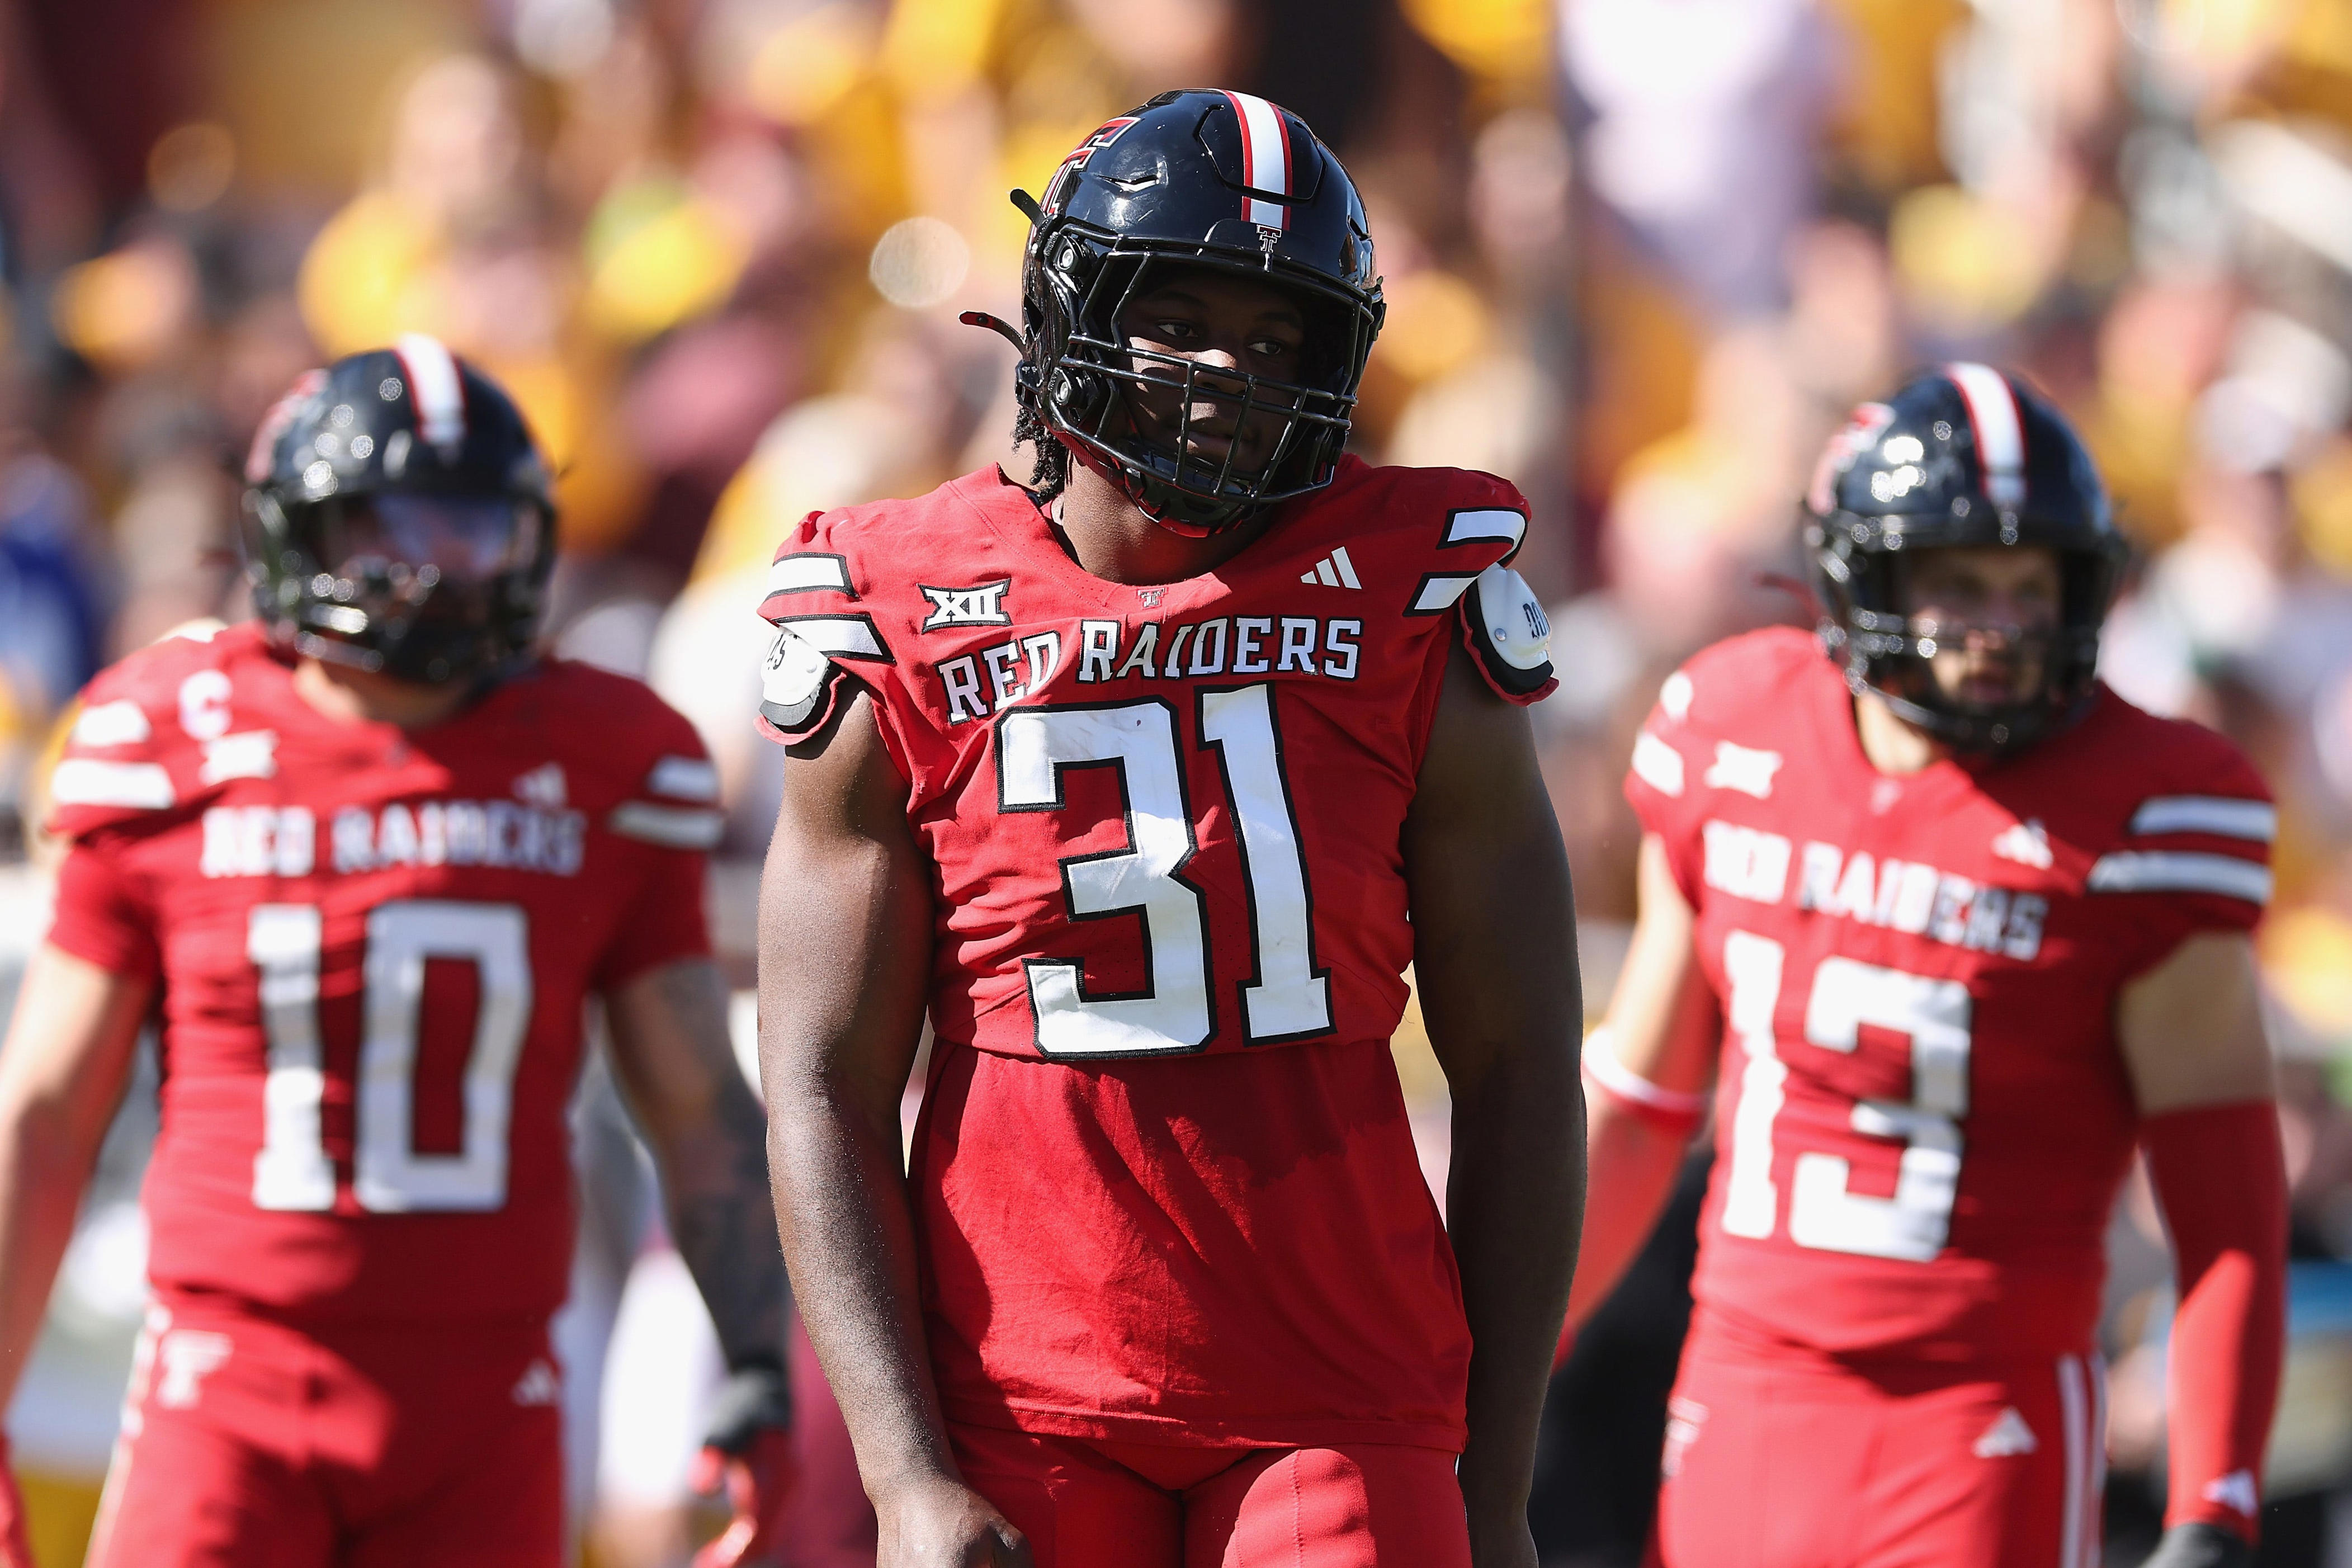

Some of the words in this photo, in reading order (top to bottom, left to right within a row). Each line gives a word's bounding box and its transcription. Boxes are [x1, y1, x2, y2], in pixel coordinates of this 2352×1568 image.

[918, 578, 1012, 634] XII
[935, 630, 1062, 725] RED
[1076, 616, 1362, 683] RAIDERS
[994, 680, 1338, 1061] 31
[246, 899, 534, 1213] 10
[1721, 928, 1974, 1265] 13
